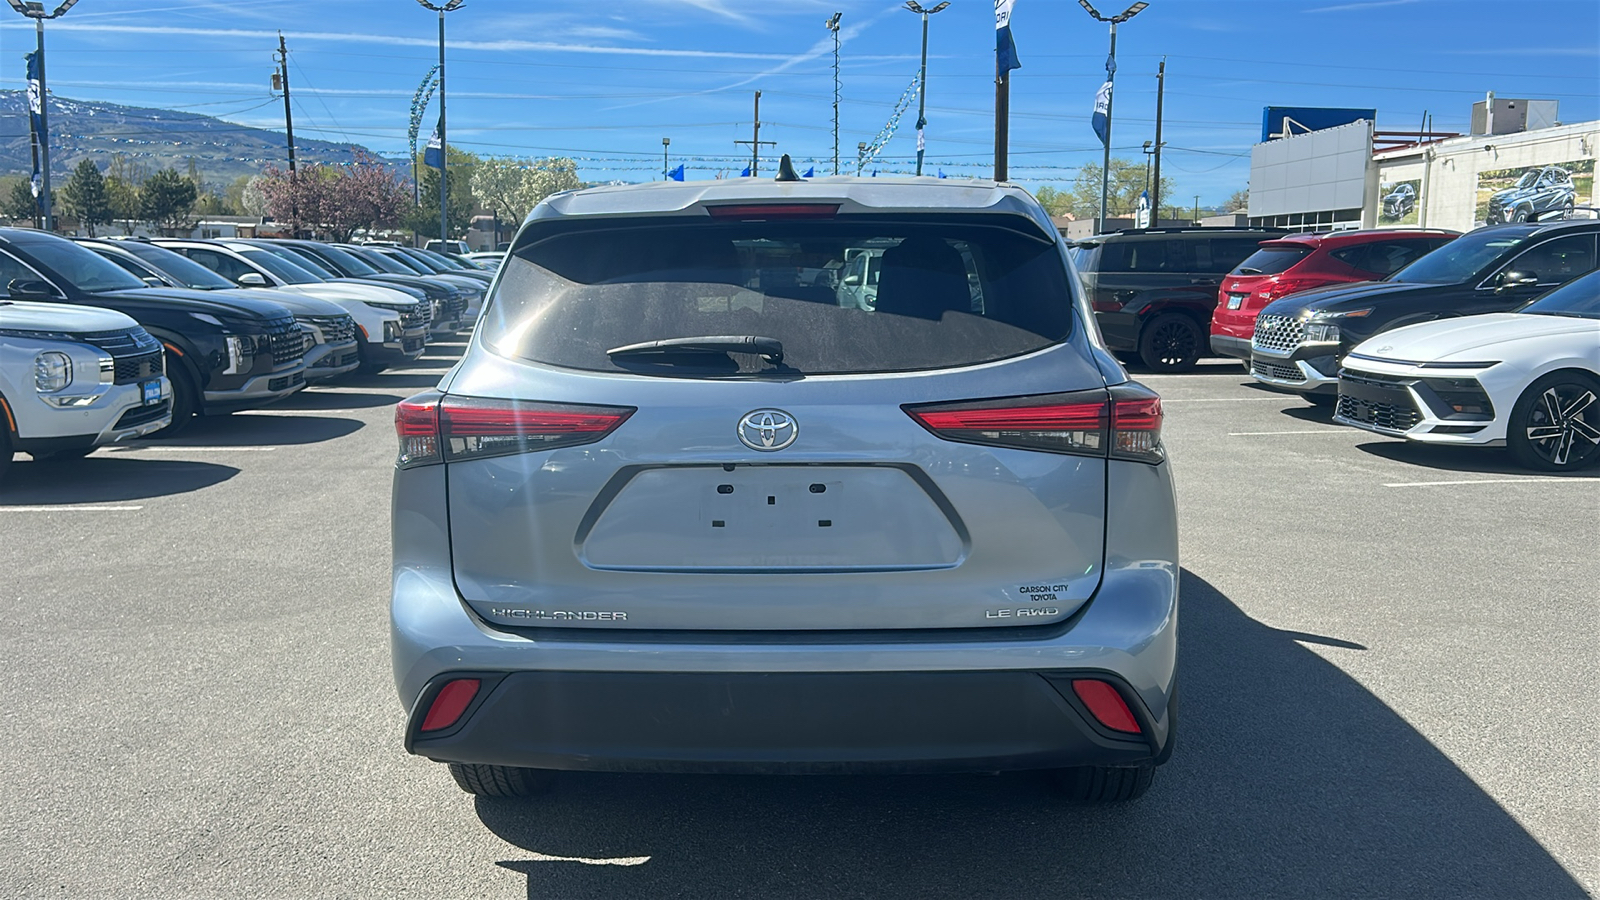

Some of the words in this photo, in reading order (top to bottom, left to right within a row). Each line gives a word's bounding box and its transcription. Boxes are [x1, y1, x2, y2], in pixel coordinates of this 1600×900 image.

[1019, 585, 1051, 593] CARSON
[492, 608, 628, 620] HIGHLANDER
[985, 609, 1011, 619] LE
[1016, 607, 1059, 617] AWD
